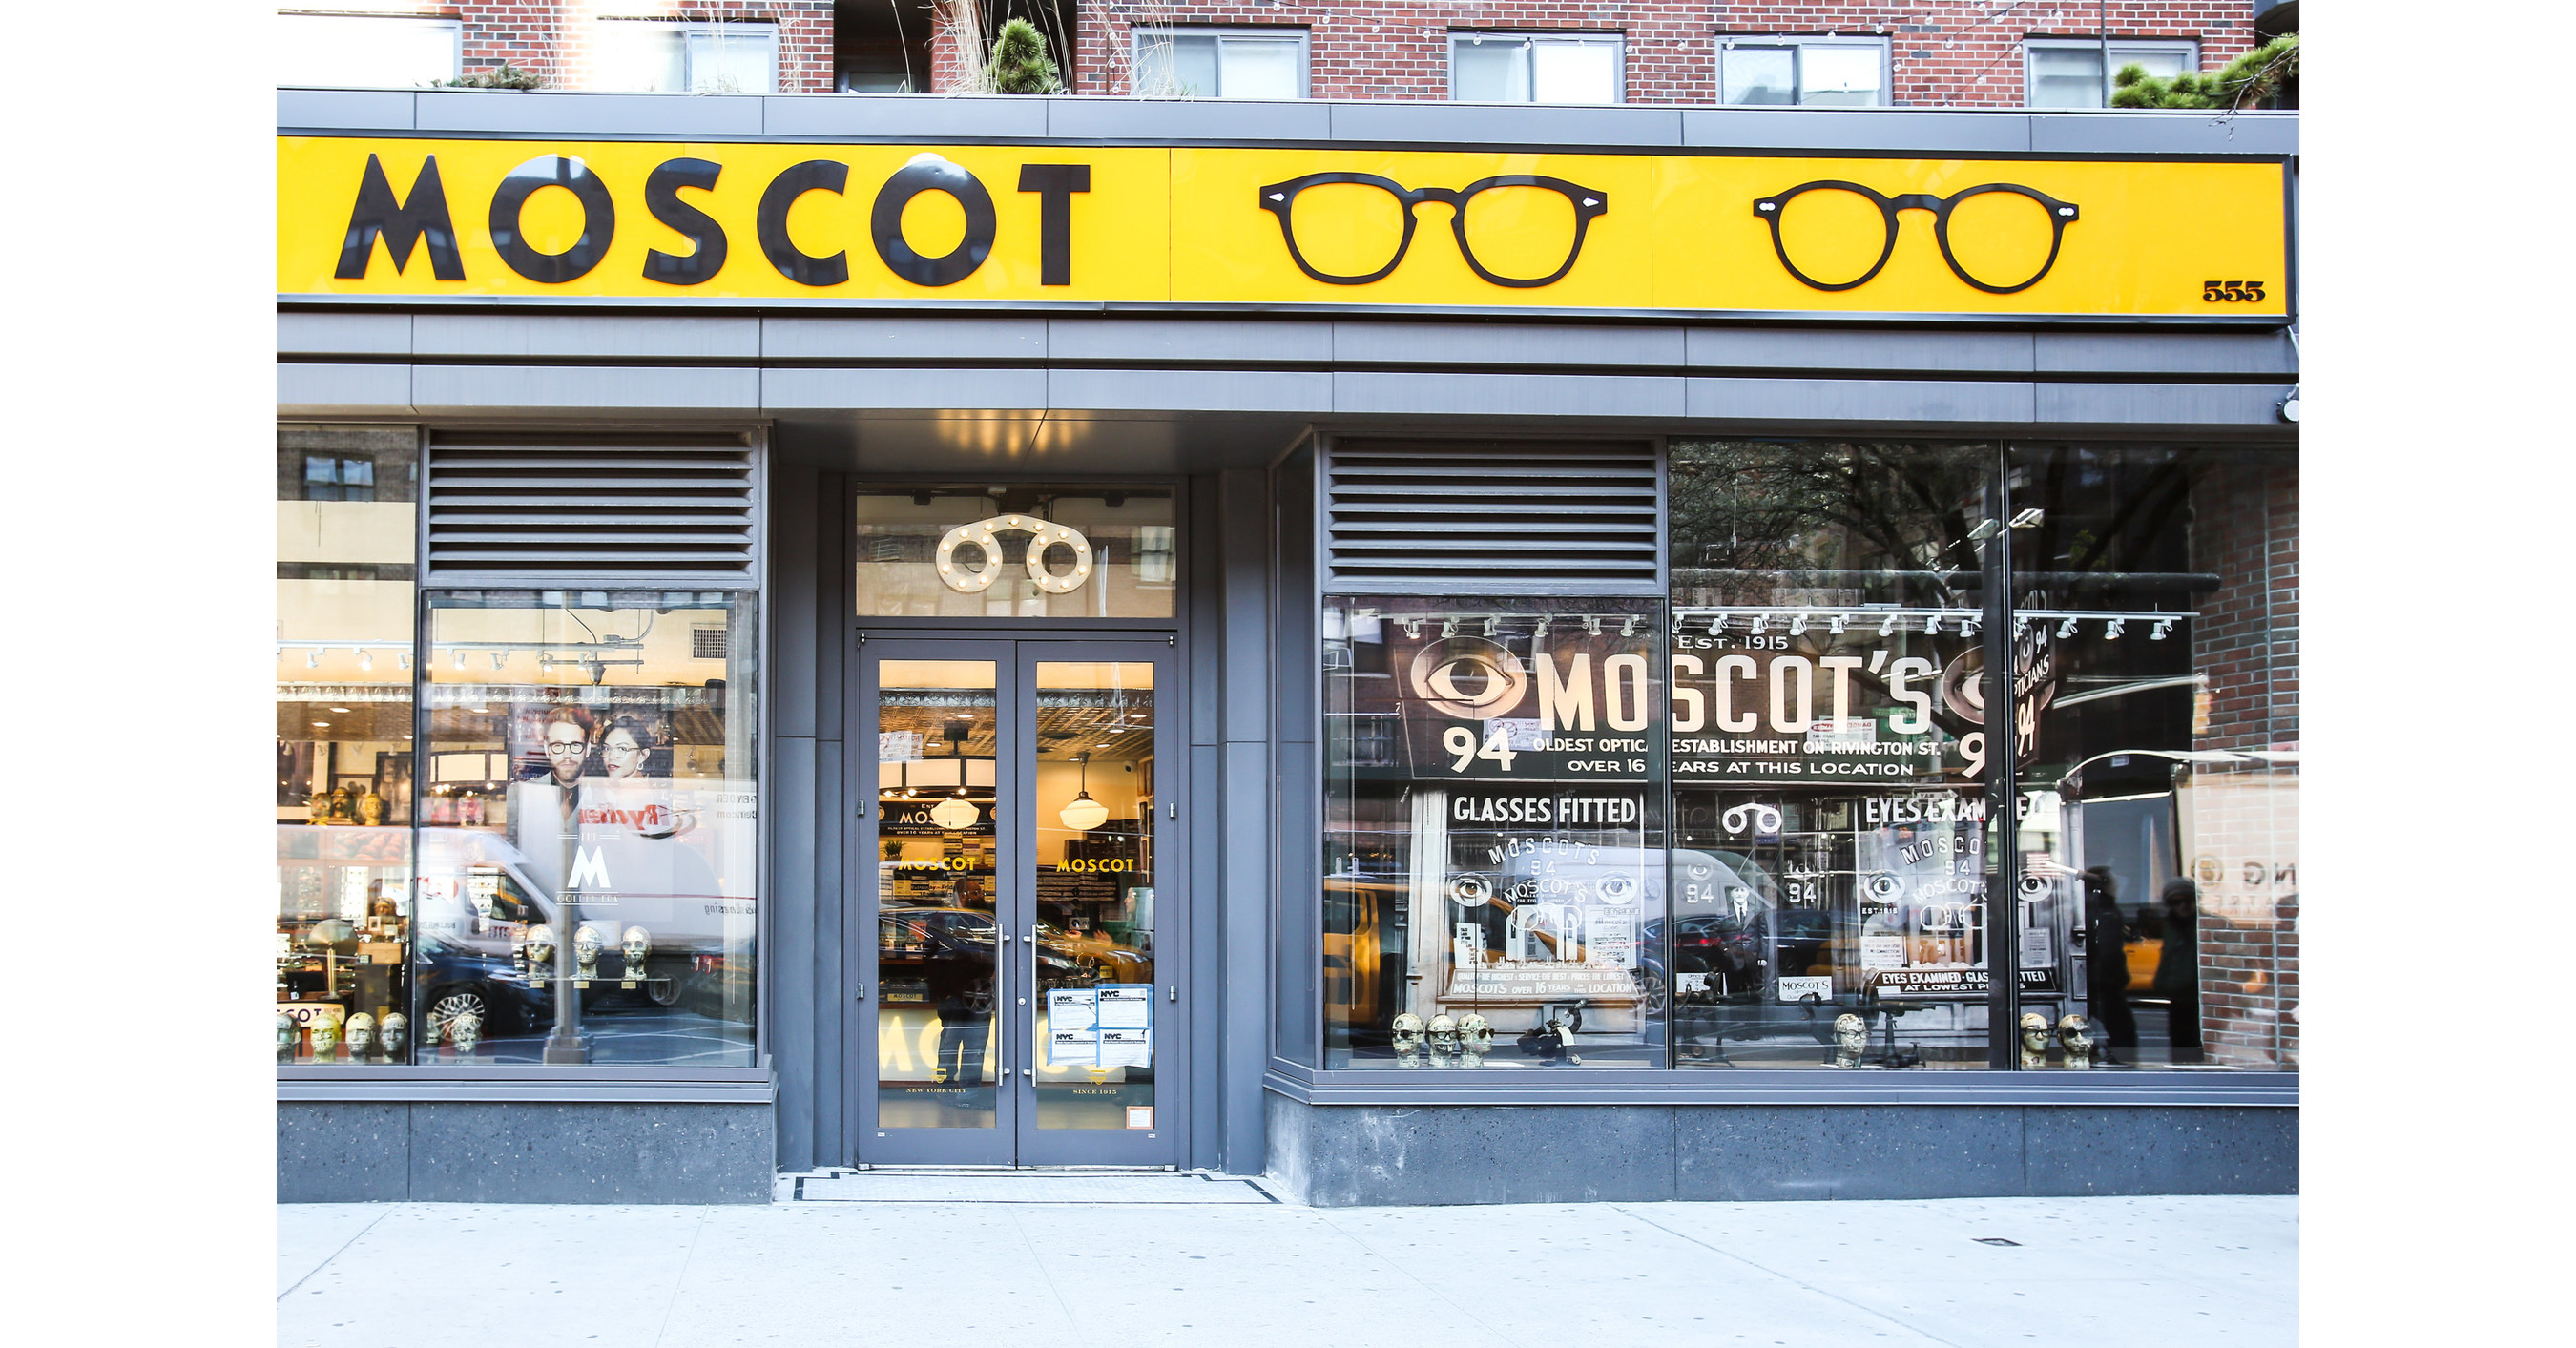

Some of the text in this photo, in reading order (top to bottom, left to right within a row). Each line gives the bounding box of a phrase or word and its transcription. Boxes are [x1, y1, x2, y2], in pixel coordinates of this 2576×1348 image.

[333, 152, 1091, 286] MOSCOT
[2202, 280, 2266, 302] 555
[1745, 635, 1789, 650] 1915
[2035, 624, 2048, 654] 94
[2014, 654, 2050, 698] TICIANS
[1535, 650, 1933, 735] MOSCOT'S
[2017, 694, 2036, 757] 94
[1443, 726, 1518, 774] 94
[1532, 737, 1594, 753] OLDEST
[1602, 737, 1649, 753] OPTIC
[1672, 738, 1798, 755] ESTABLISHMENT
[1803, 740, 1825, 755] ON
[1831, 741, 1913, 756] RIVINGTON
[1918, 741, 1942, 756] ST.
[1959, 731, 1986, 778] 9
[1568, 758, 1914, 776] OVER 16 ARS AT THIS LOCATION
[1454, 796, 1636, 823] GLASSES FITTED
[1866, 798, 1921, 823] EYES
[1487, 837, 1600, 866] MOSCOT'S
[1900, 835, 1981, 865] MOSCO
[567, 845, 612, 888] M
[898, 857, 976, 871] MOSCOT
[1056, 858, 1134, 873] MOSCOT
[1530, 860, 1557, 876] 94
[1944, 859, 1971, 876] 94
[1504, 879, 1589, 903] MOSCOT'S
[1686, 883, 1714, 903] 94
[1788, 883, 1817, 903] 94
[1535, 981, 1547, 994] 16
[1548, 984, 1571, 993] YEARS
[1589, 983, 1632, 994] LOCATION
[1882, 972, 1908, 985] EYES
